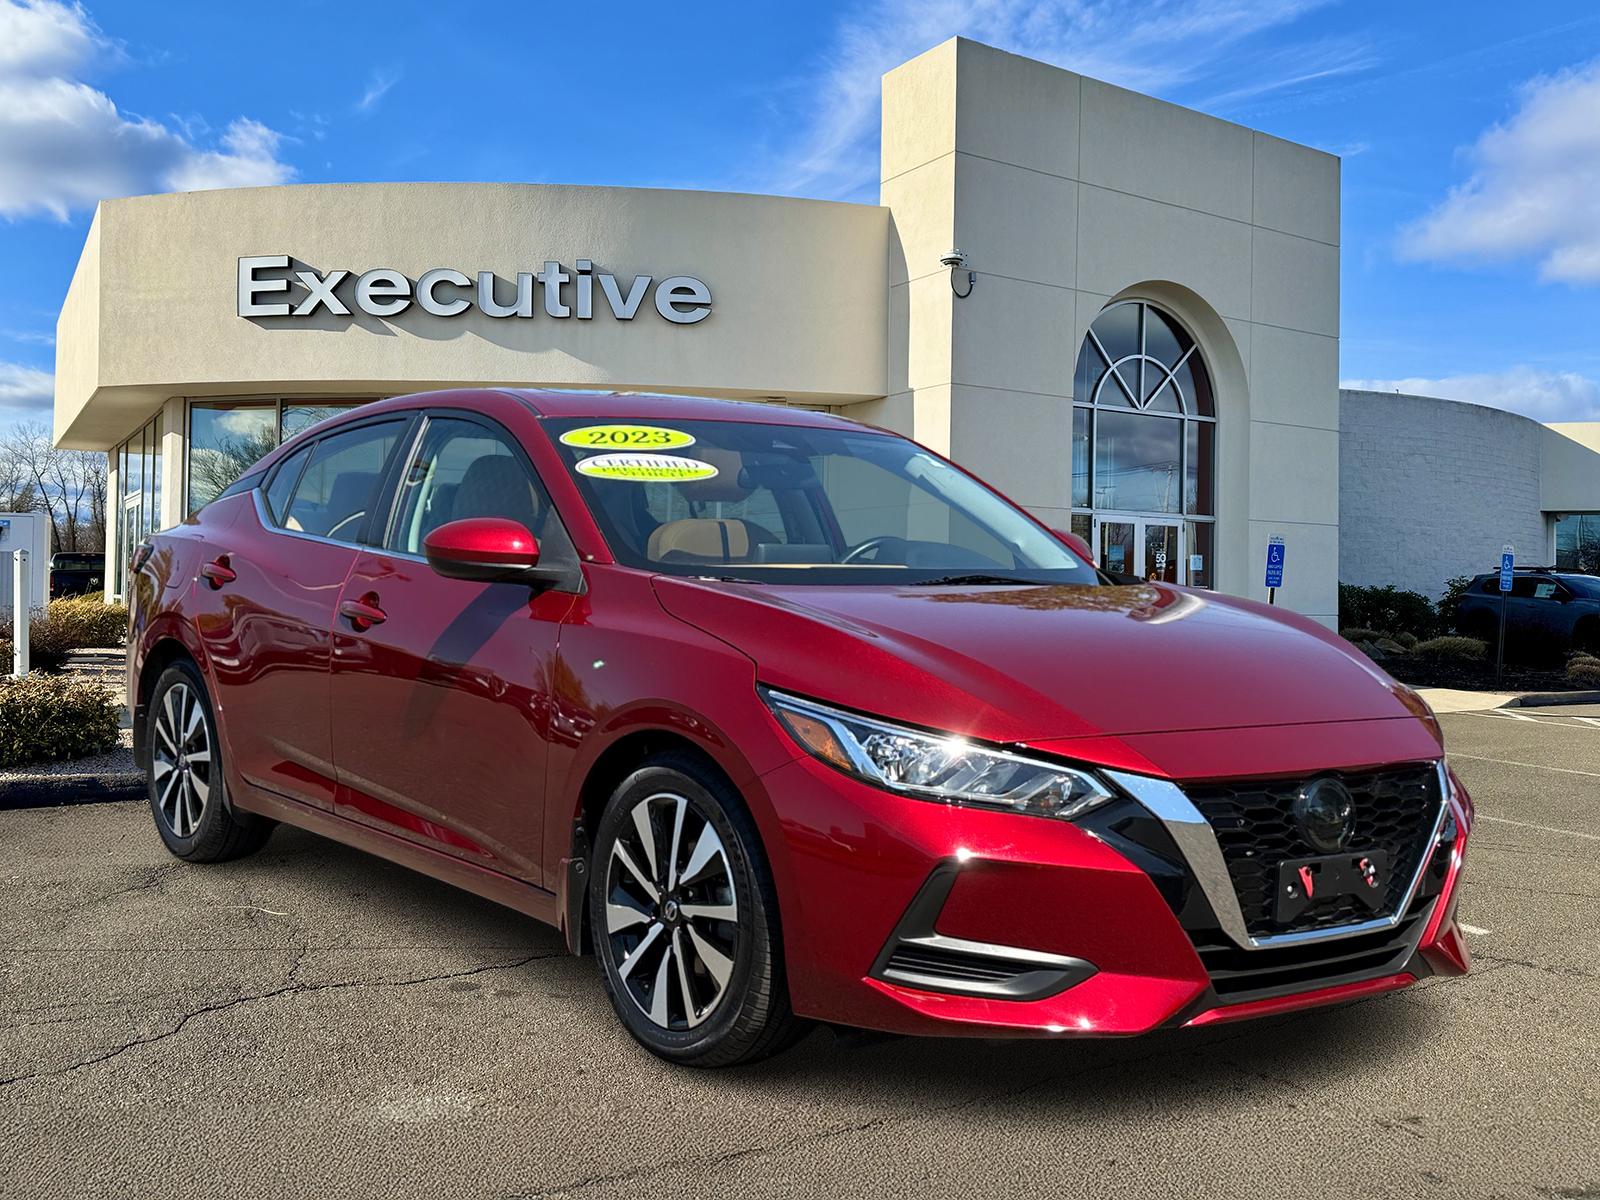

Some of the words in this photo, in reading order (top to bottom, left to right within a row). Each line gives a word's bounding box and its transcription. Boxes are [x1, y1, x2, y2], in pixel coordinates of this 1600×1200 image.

[237, 254, 712, 324] Executive
[588, 431, 672, 444] 2023
[592, 459, 699, 468] CERTIFIED
